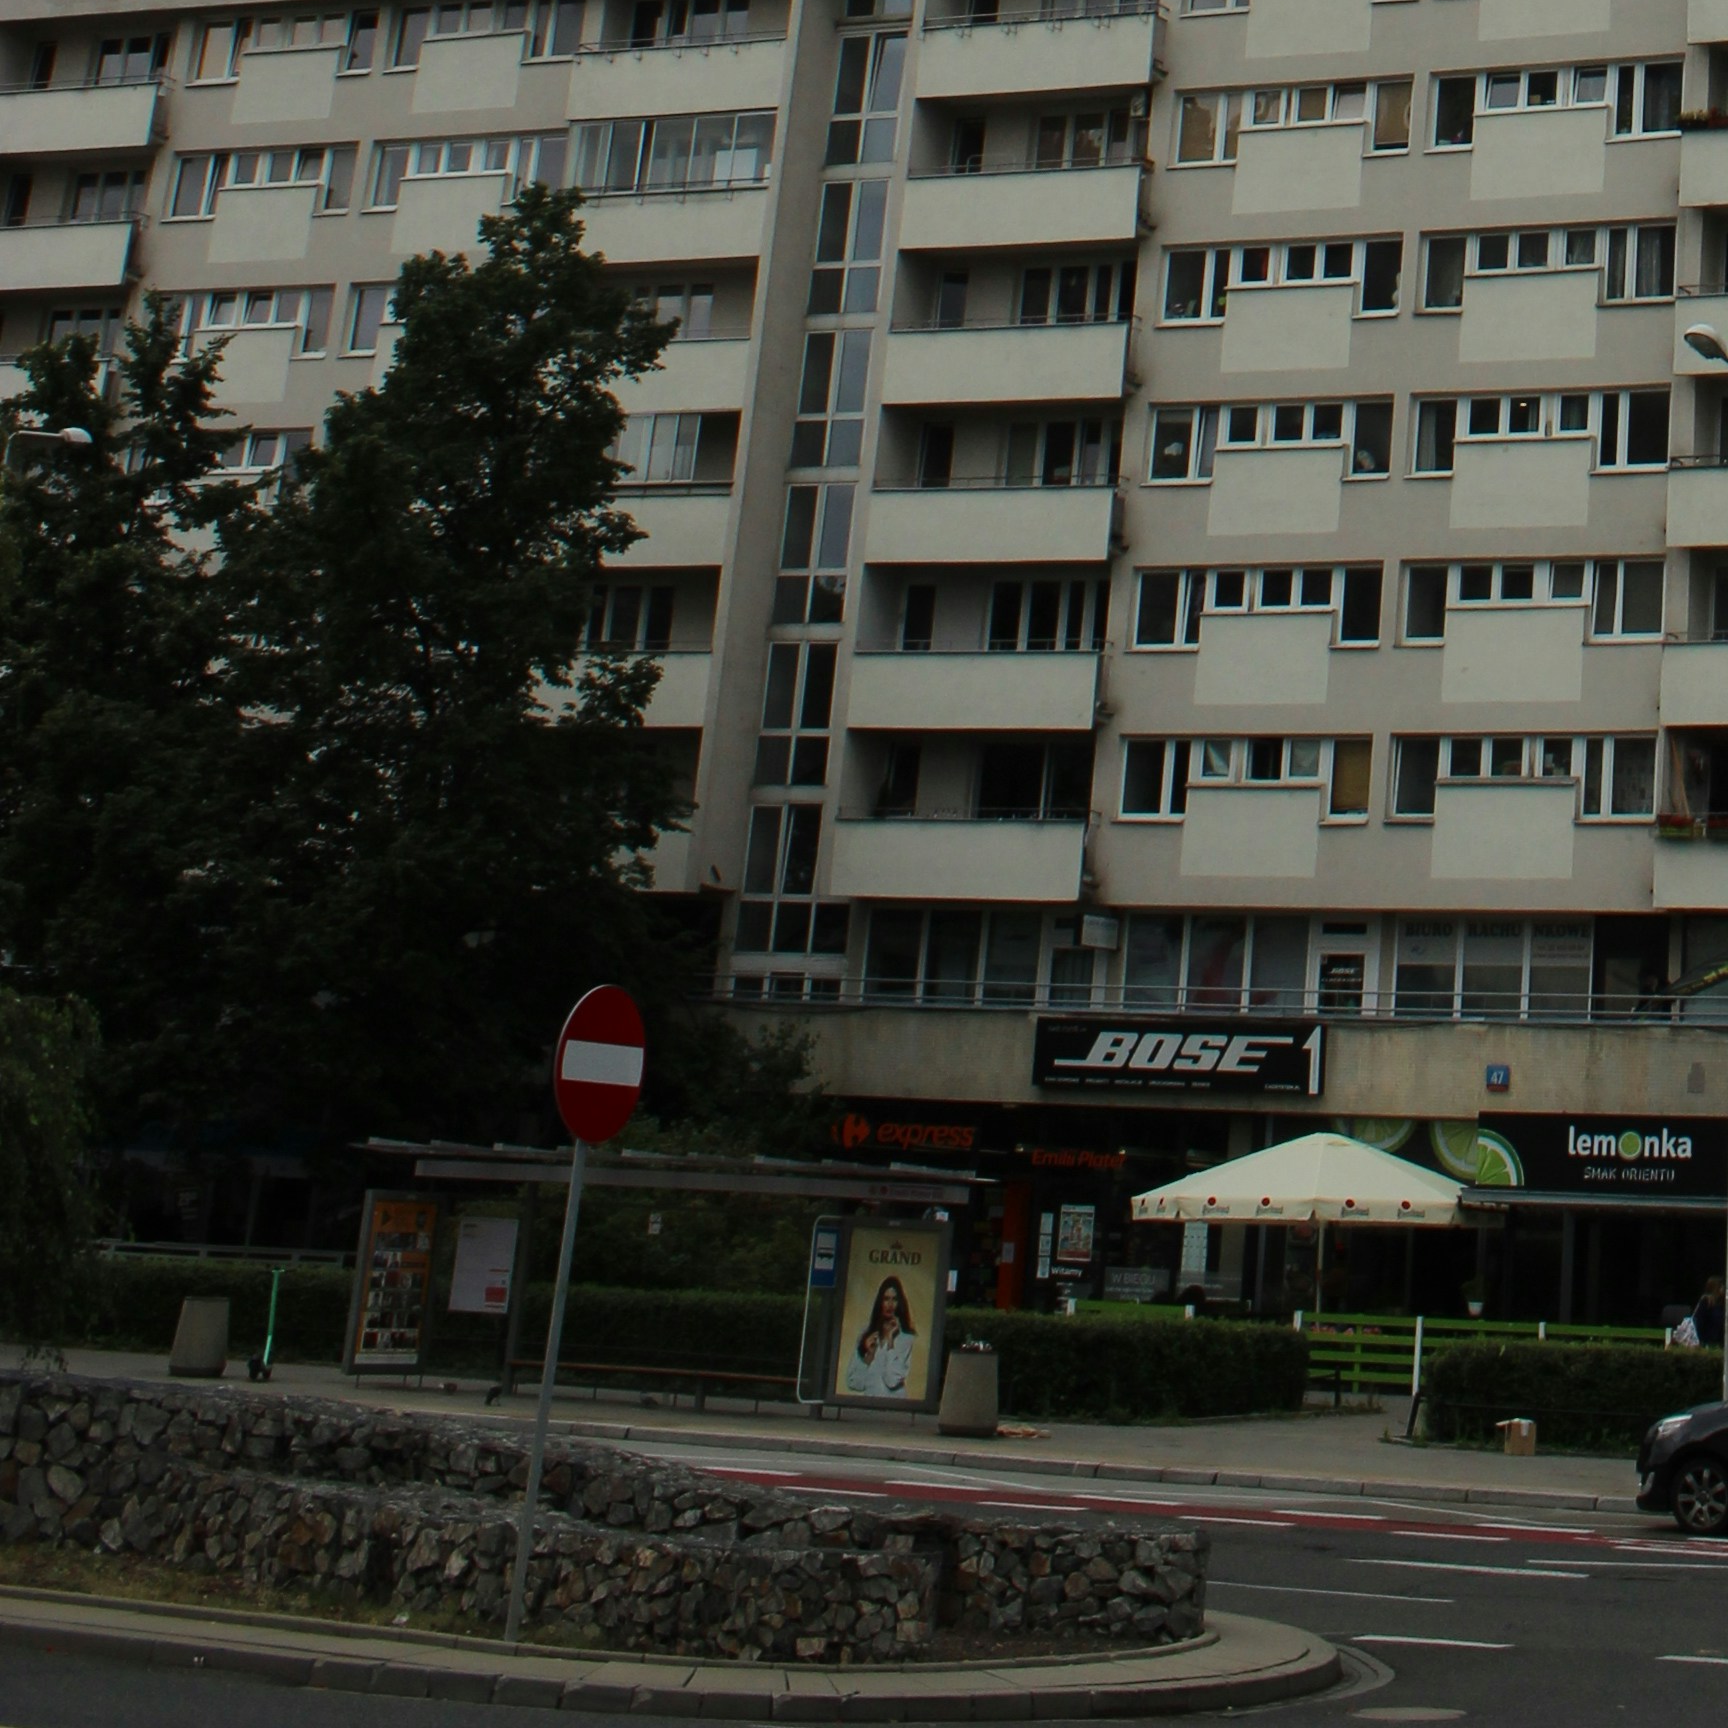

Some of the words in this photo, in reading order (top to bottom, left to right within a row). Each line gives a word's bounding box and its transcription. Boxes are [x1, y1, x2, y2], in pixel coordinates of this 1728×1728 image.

[1405, 923, 1453, 937] BIURO
[1053, 1031, 1295, 1073] BOSE
[1490, 1071, 1504, 1085] 47
[876, 1120, 976, 1150] express
[1567, 1125, 1693, 1159] lemonka
[1078, 1150, 1125, 1168] Plater
[1583, 1167, 1617, 1180] SMAK
[1621, 1168, 1675, 1182] ORIENTU
[869, 1249, 921, 1264] GRAND
[1051, 1265, 1082, 1278] Witamy
